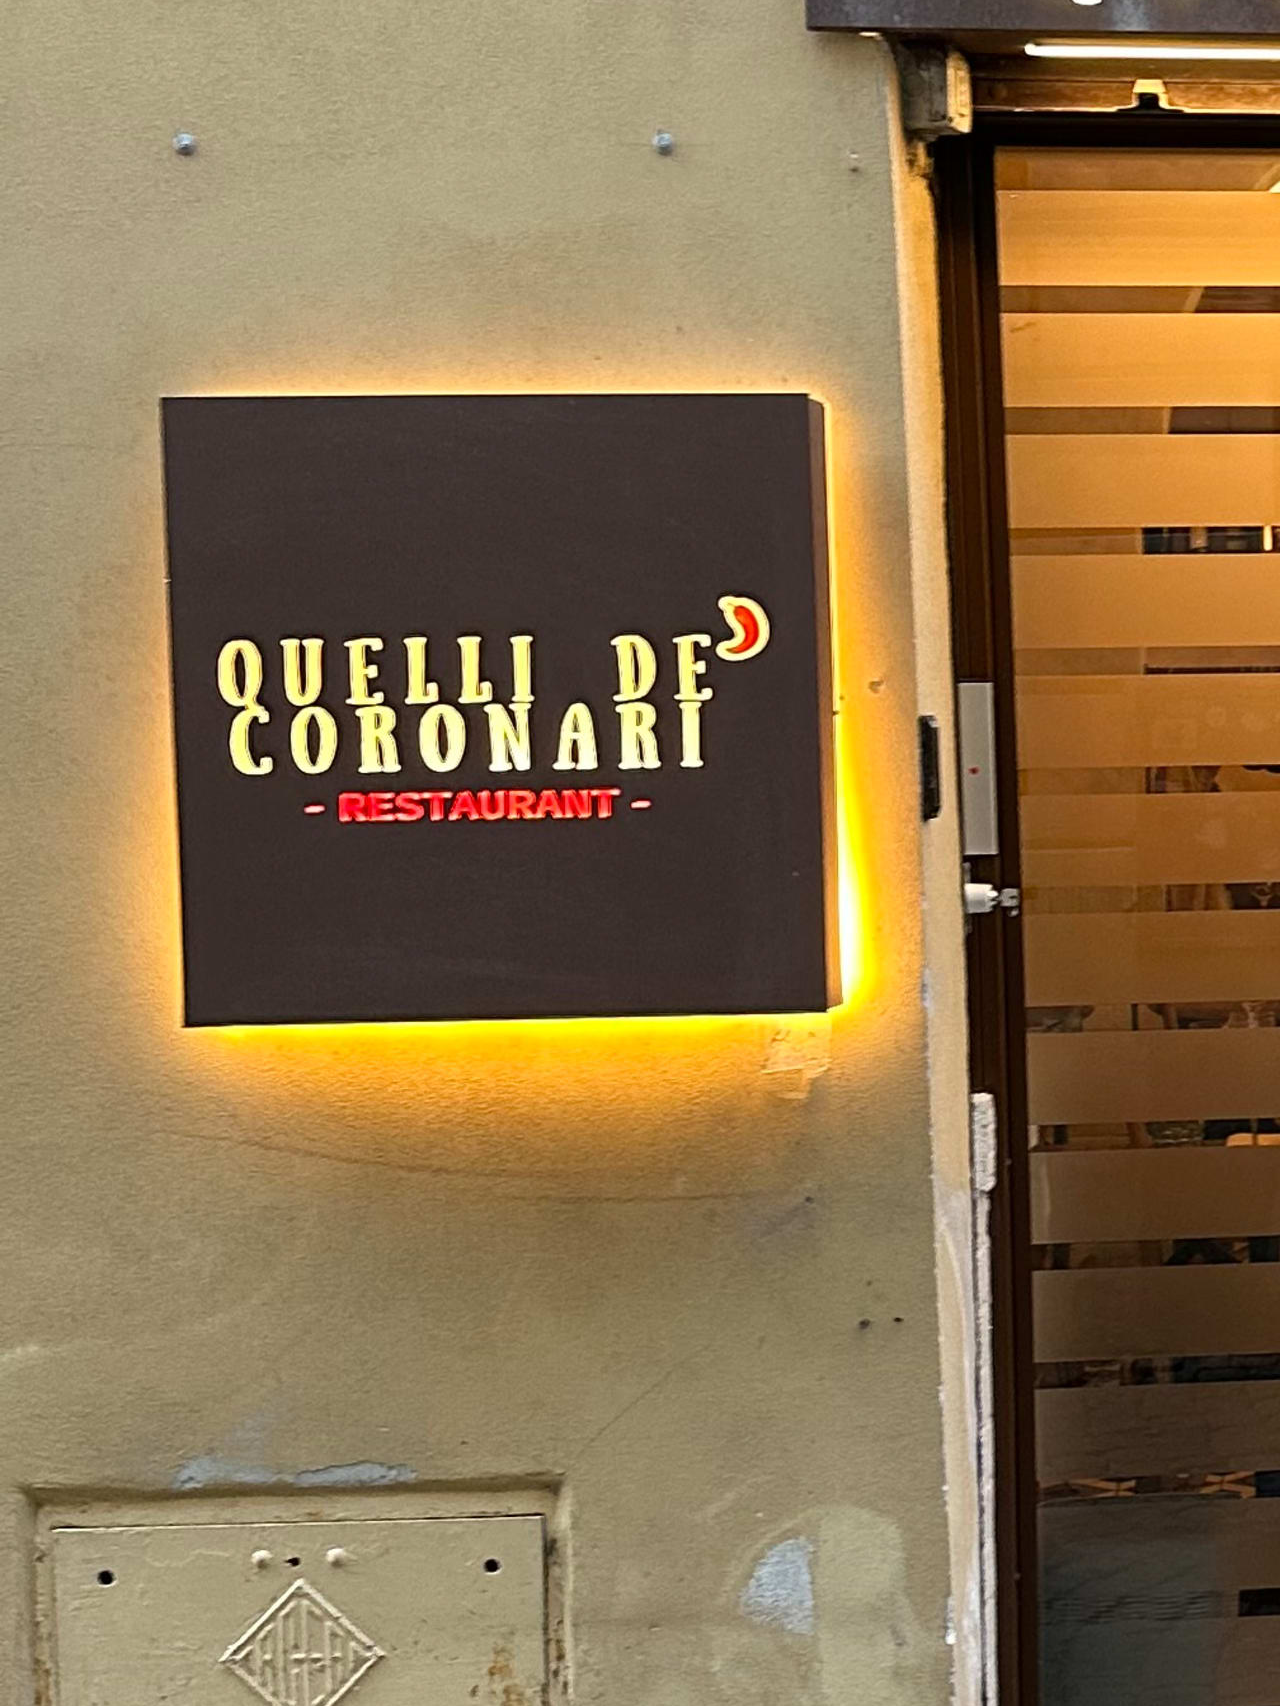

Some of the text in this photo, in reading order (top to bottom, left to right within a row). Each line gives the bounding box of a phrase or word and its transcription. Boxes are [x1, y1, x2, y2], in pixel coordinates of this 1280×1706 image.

[217, 636, 535, 709] QUELLI
[229, 702, 704, 775] CORONARI
[337, 787, 622, 823] RESTAURANT
